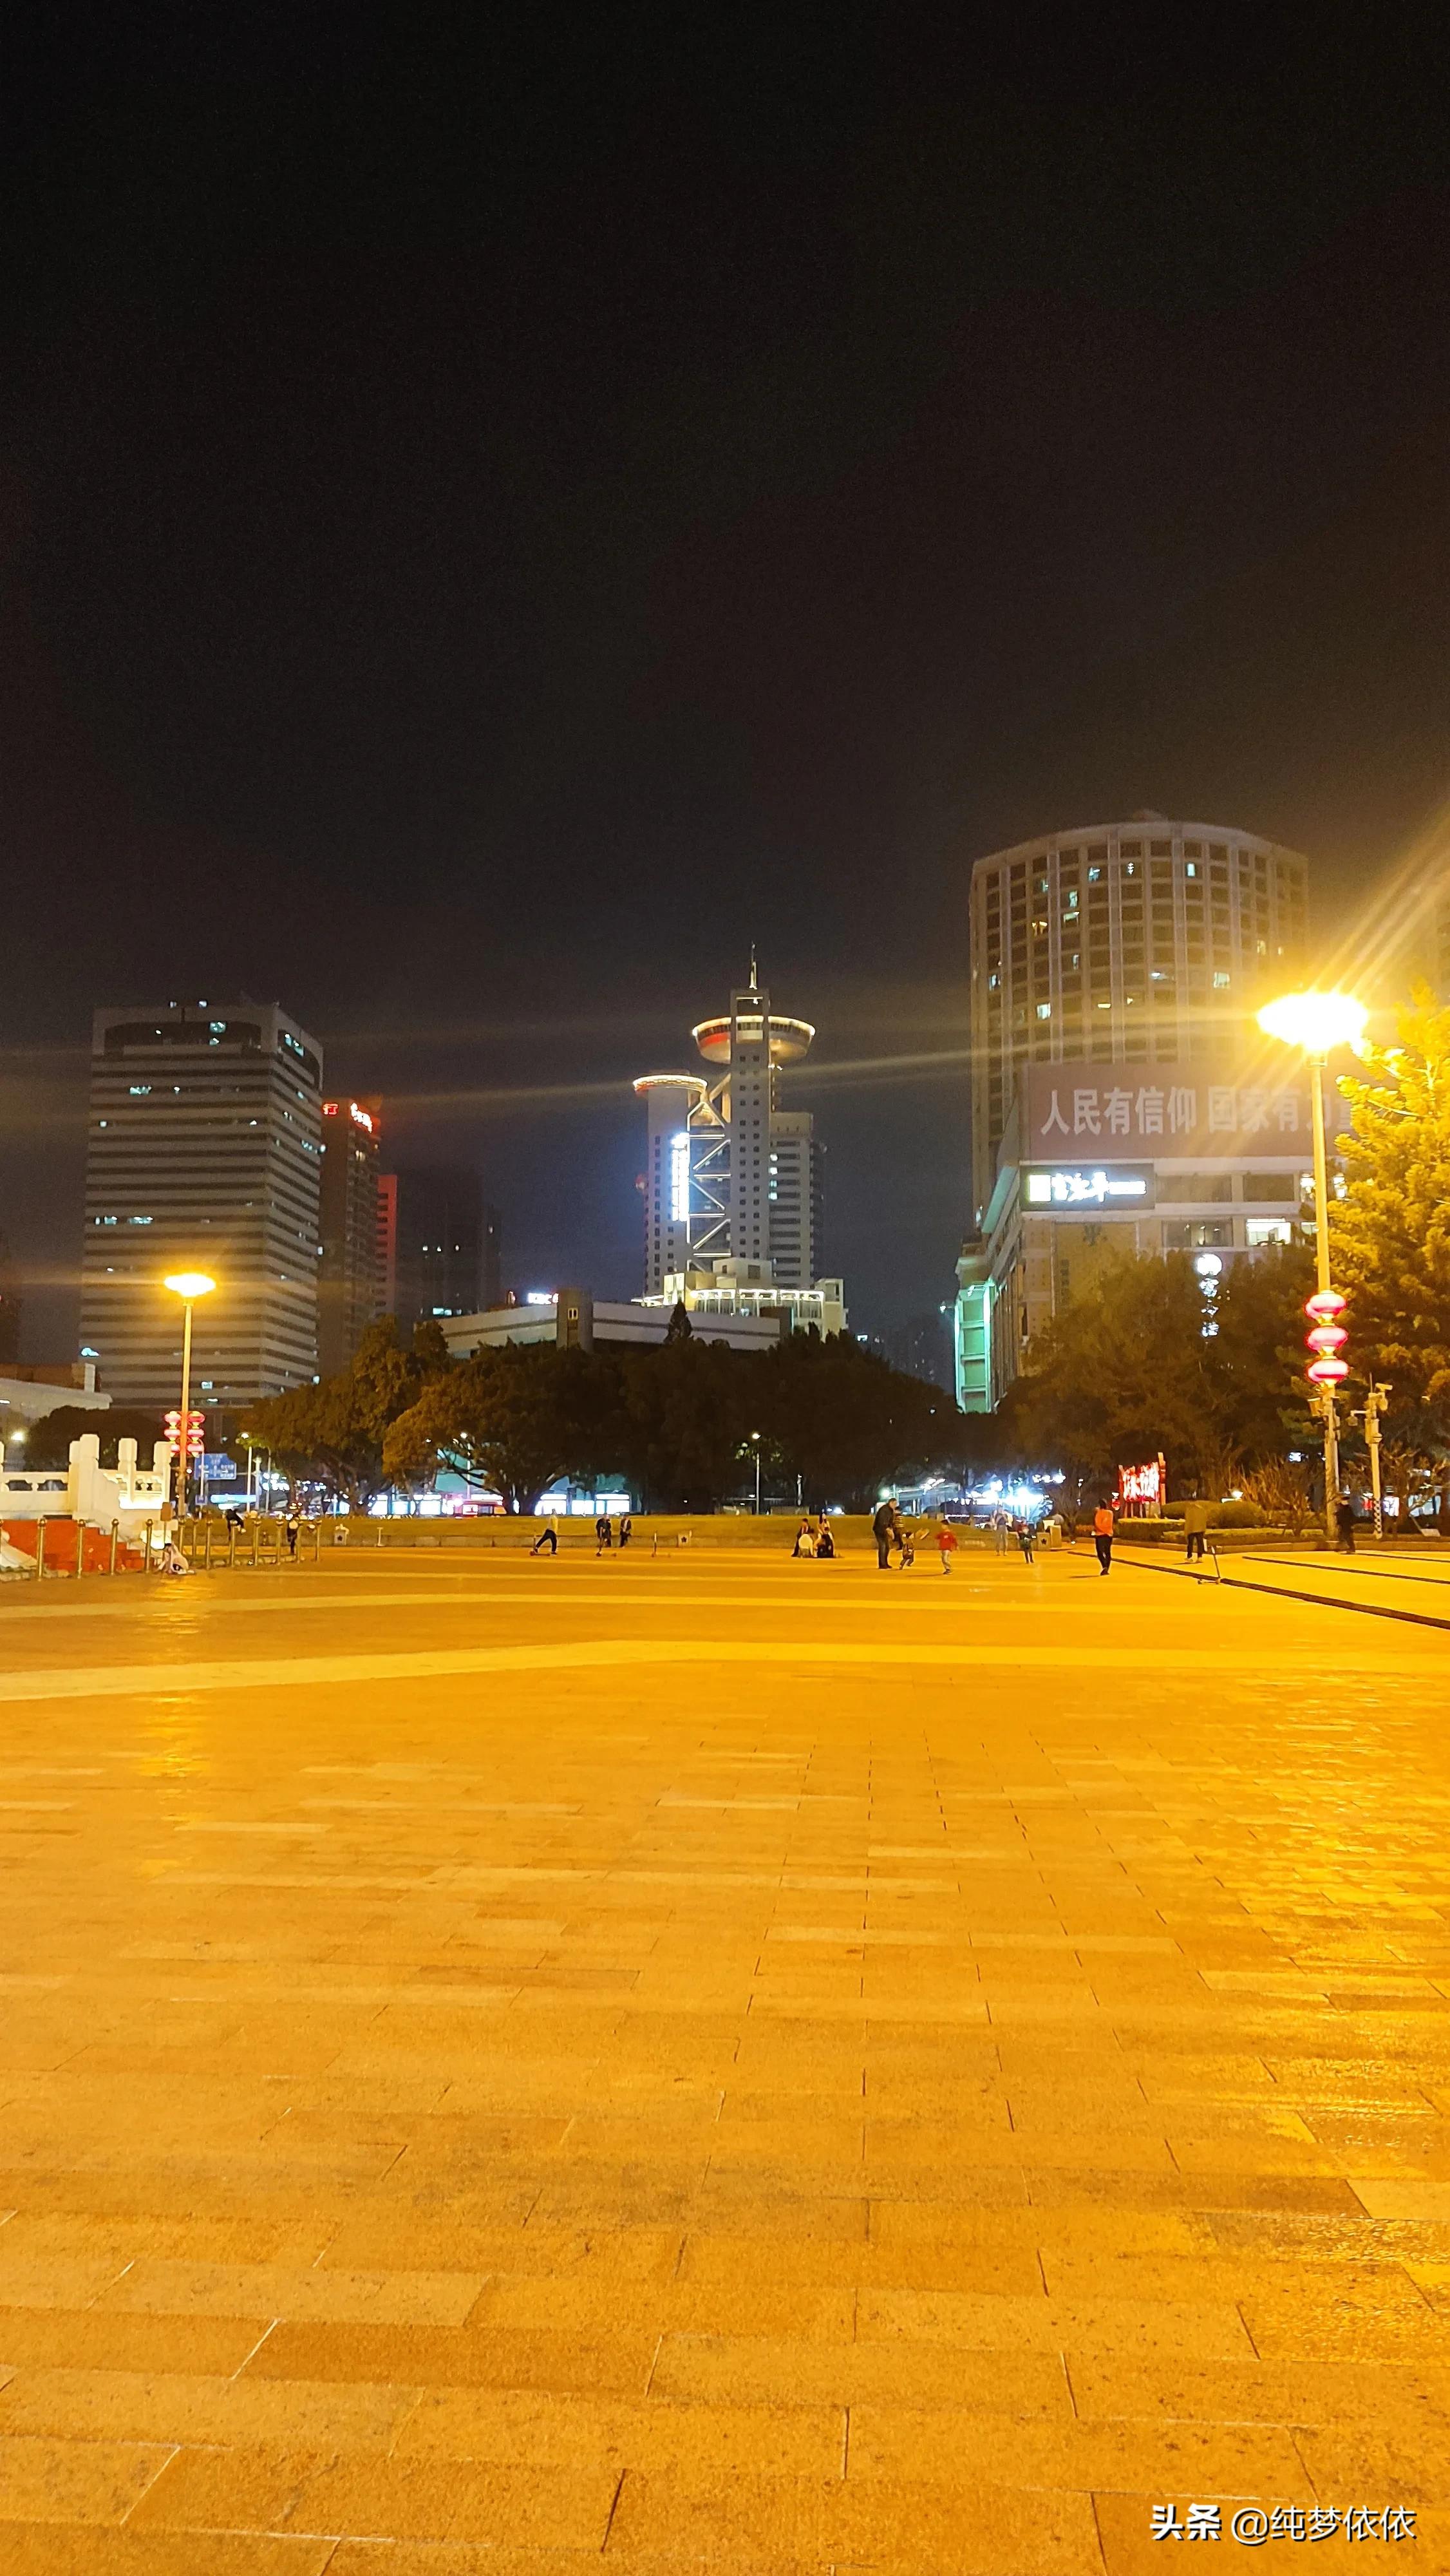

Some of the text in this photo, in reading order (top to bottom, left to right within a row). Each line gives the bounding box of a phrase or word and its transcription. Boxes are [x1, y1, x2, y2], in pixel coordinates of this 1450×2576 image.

[1040, 1086, 1196, 1135] 人民有信仰
